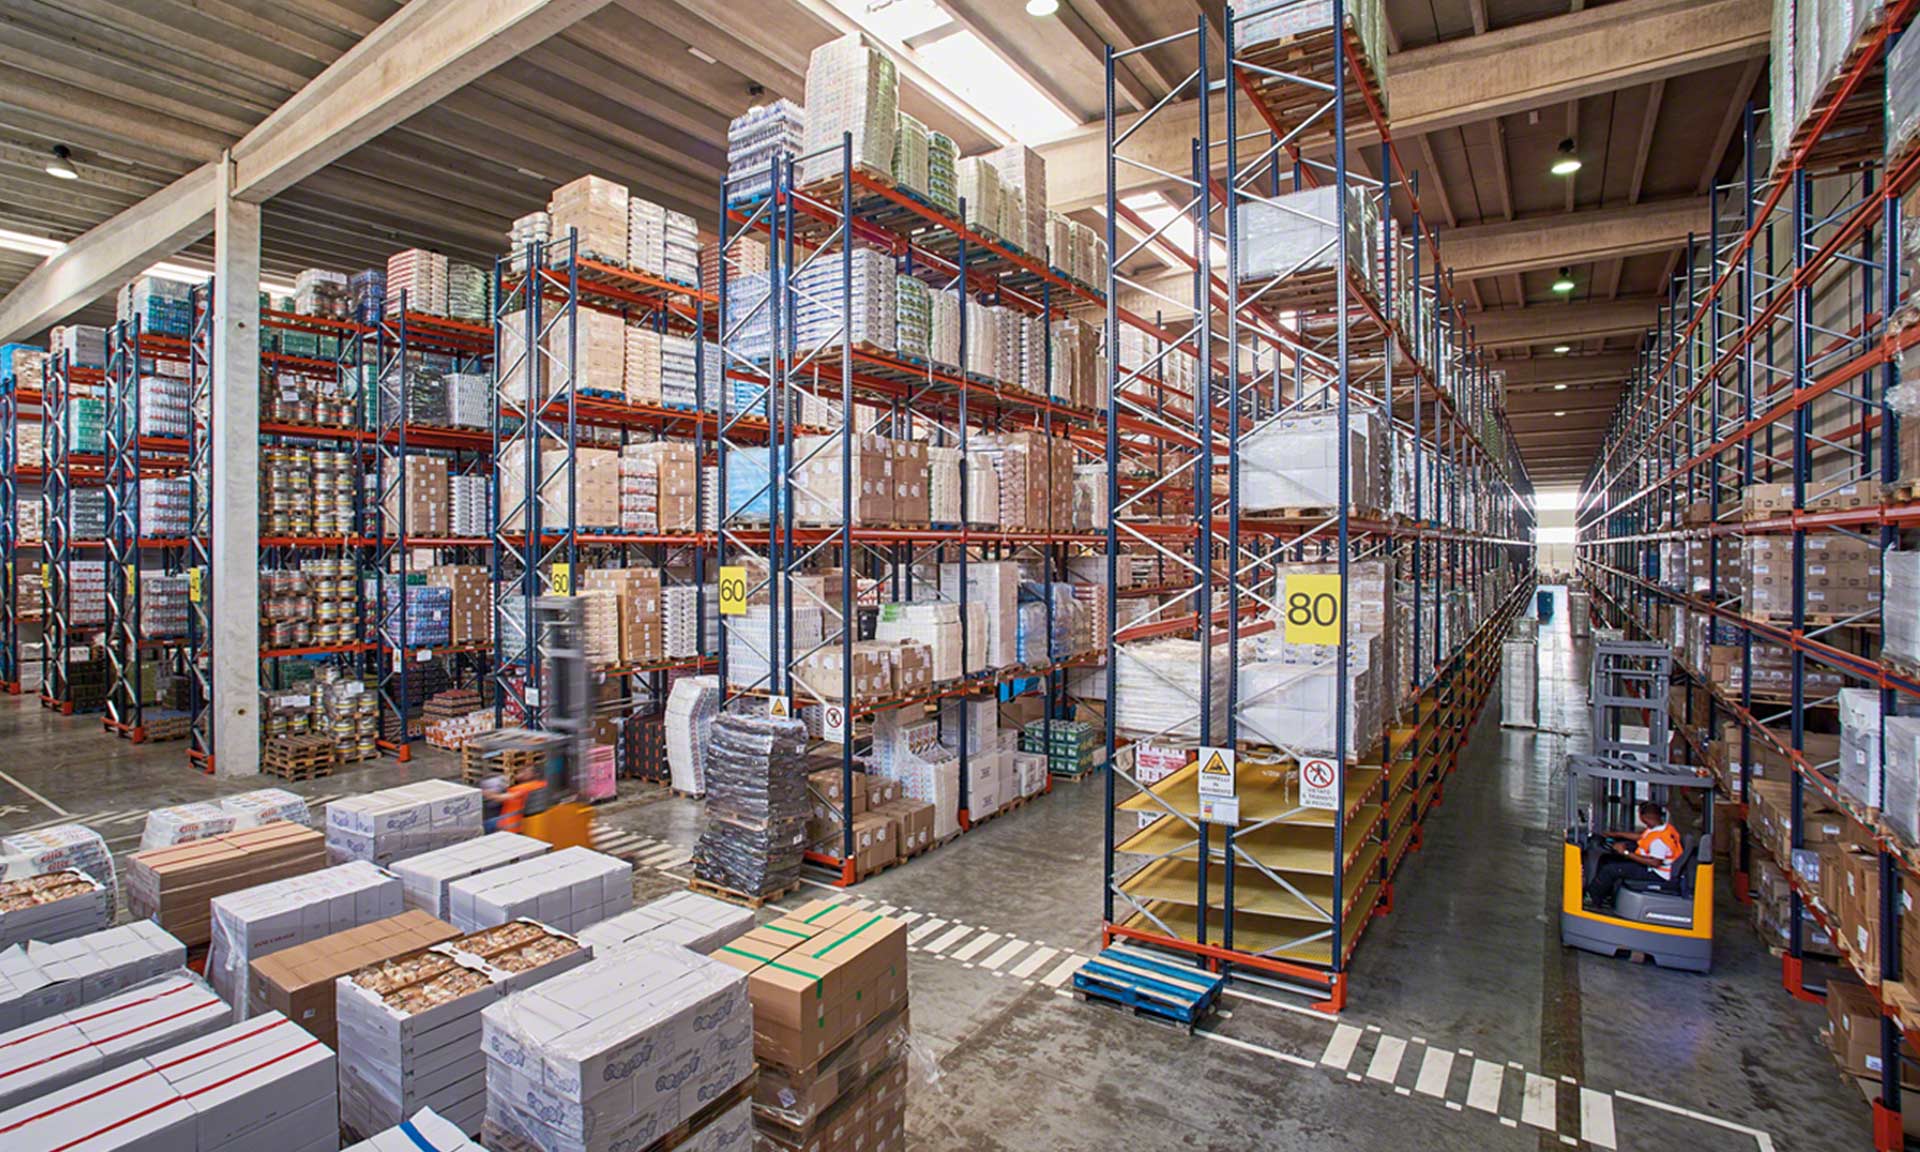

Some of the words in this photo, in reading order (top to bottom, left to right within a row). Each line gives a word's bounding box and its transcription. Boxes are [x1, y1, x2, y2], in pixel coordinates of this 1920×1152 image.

[553, 573, 568, 593] 60
[721, 578, 745, 602] 60
[1288, 592, 1338, 627] 80
